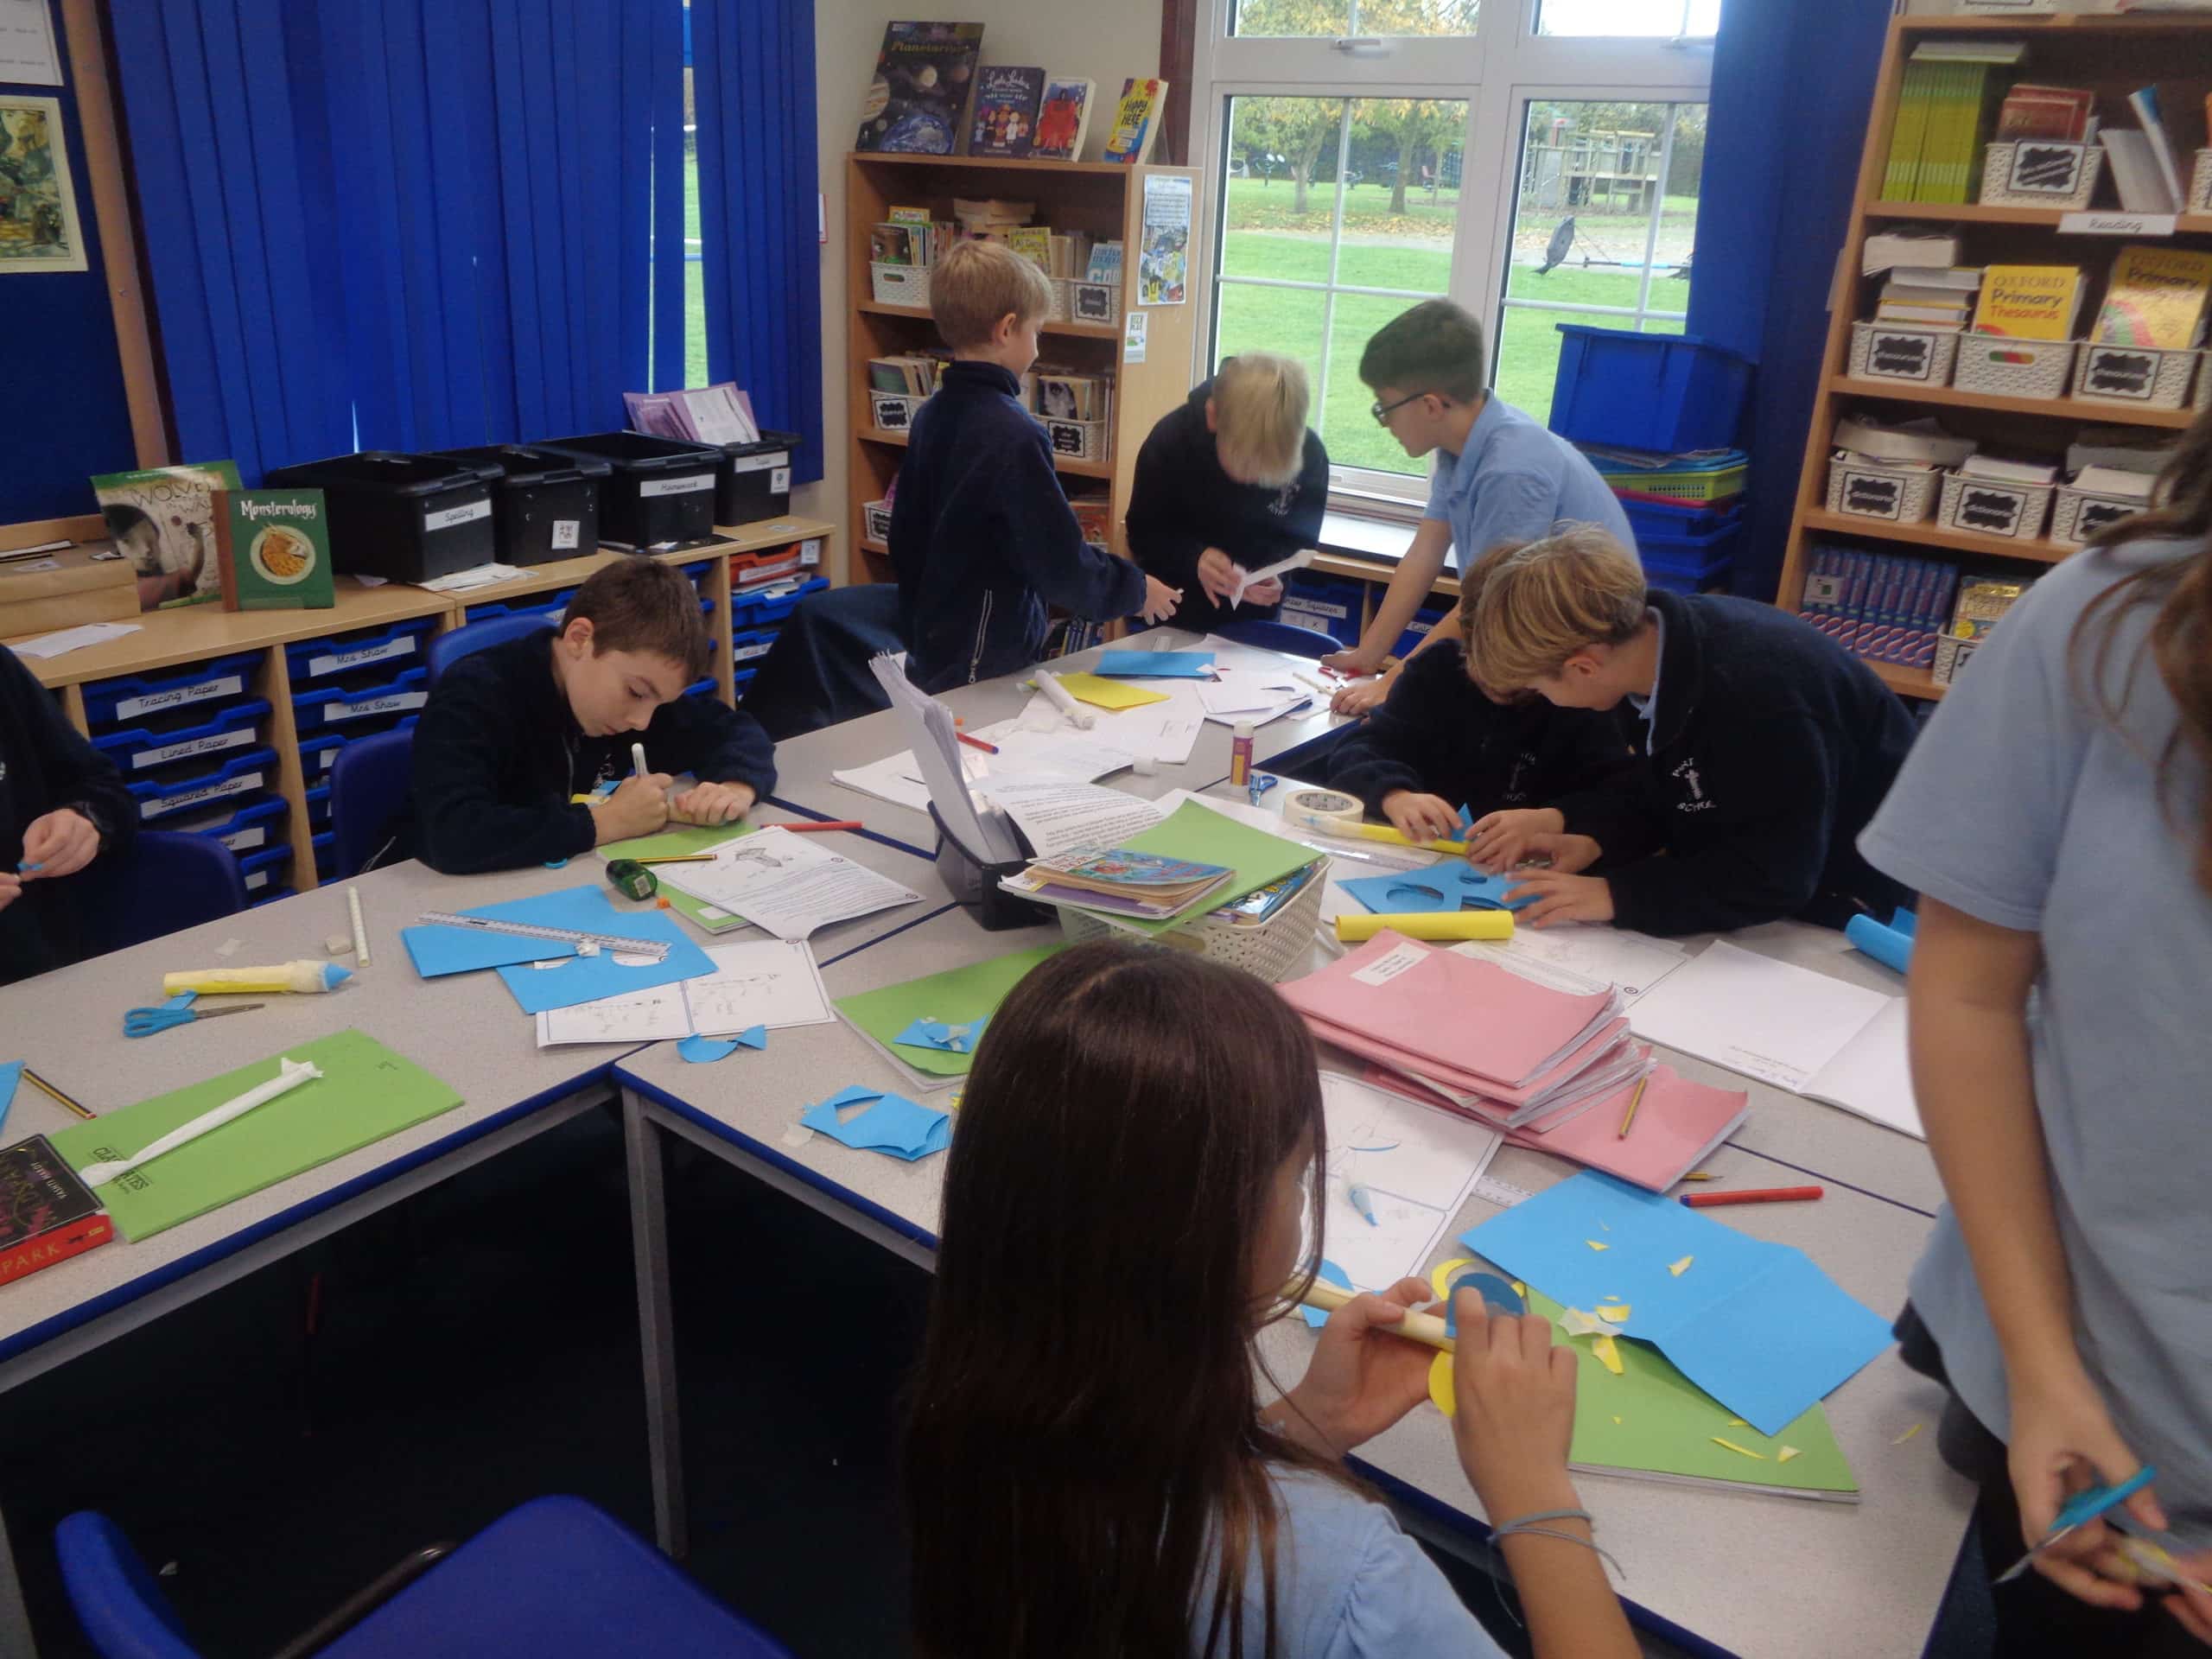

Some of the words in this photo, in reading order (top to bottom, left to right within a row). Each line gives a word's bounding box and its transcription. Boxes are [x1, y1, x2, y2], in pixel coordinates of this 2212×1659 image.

[2089, 219, 2143, 234] Reading
[1992, 289, 2063, 308] Primary
[1991, 305, 2060, 320] Thesaurus
[240, 499, 317, 520] Monsterology
[337, 654, 357, 664] Mrs
[360, 648, 388, 659] Shaw
[138, 690, 182, 709] Tracing
[188, 684, 219, 696] Paper
[350, 703, 370, 714] Mrs
[373, 701, 401, 710] Shaw
[161, 745, 194, 760] Lined
[198, 738, 229, 750] Paper
[161, 787, 208, 809] Squared
[213, 780, 243, 793] Paper
